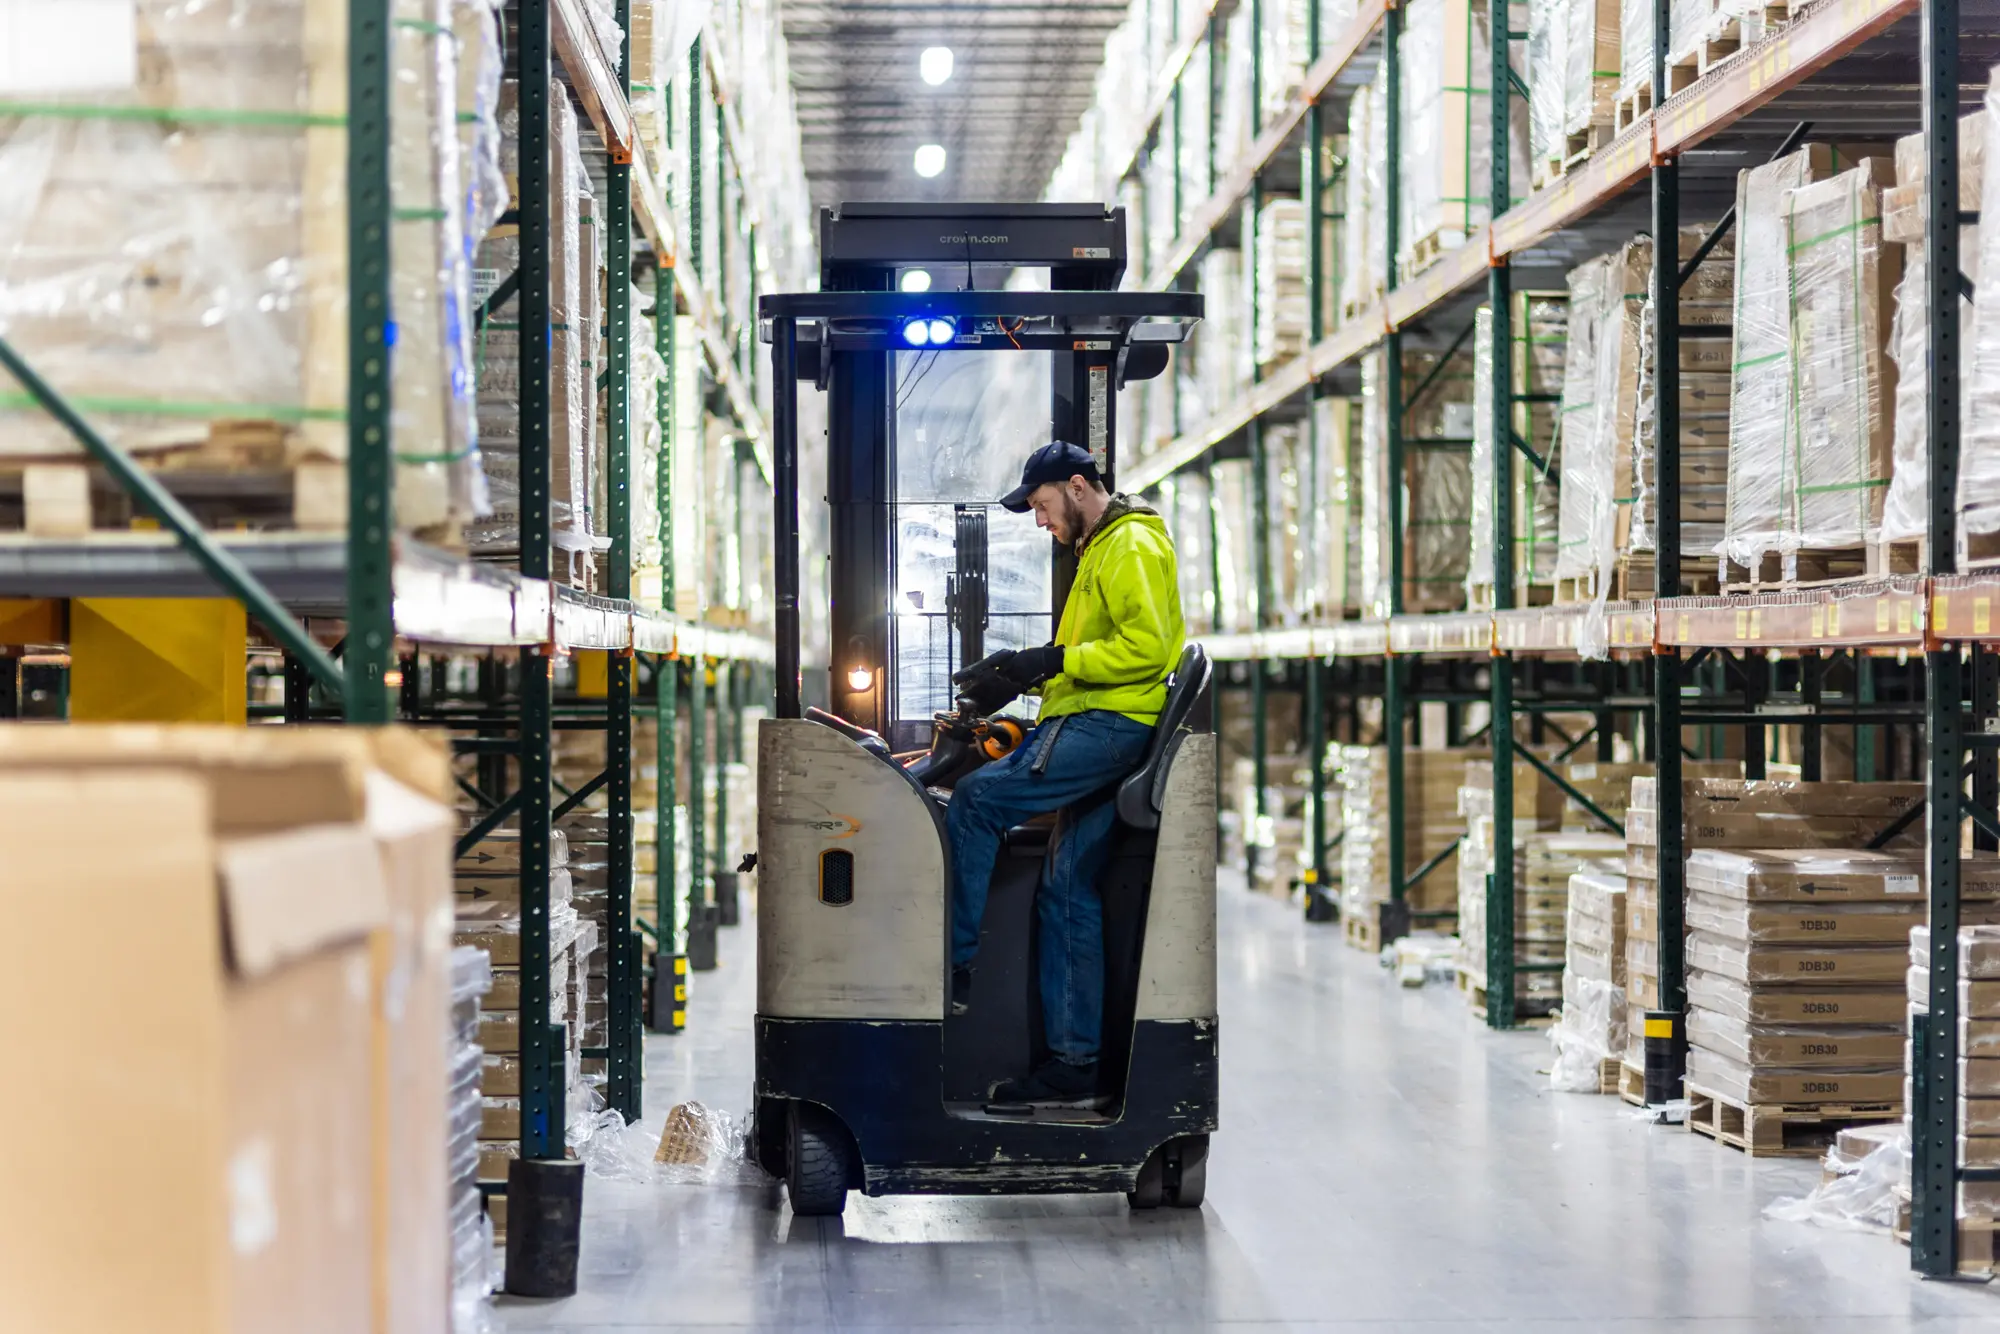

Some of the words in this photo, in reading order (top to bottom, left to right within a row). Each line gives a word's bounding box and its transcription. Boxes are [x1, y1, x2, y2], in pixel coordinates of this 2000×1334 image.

[940, 235, 1008, 243] crown.com
[1800, 920, 1837, 931] 3DB30
[1799, 961, 1836, 971] 3DB30
[1802, 1003, 1839, 1014] 3DB30
[1801, 1045, 1838, 1055] 3DB30
[1802, 1083, 1839, 1093] 3DB30
